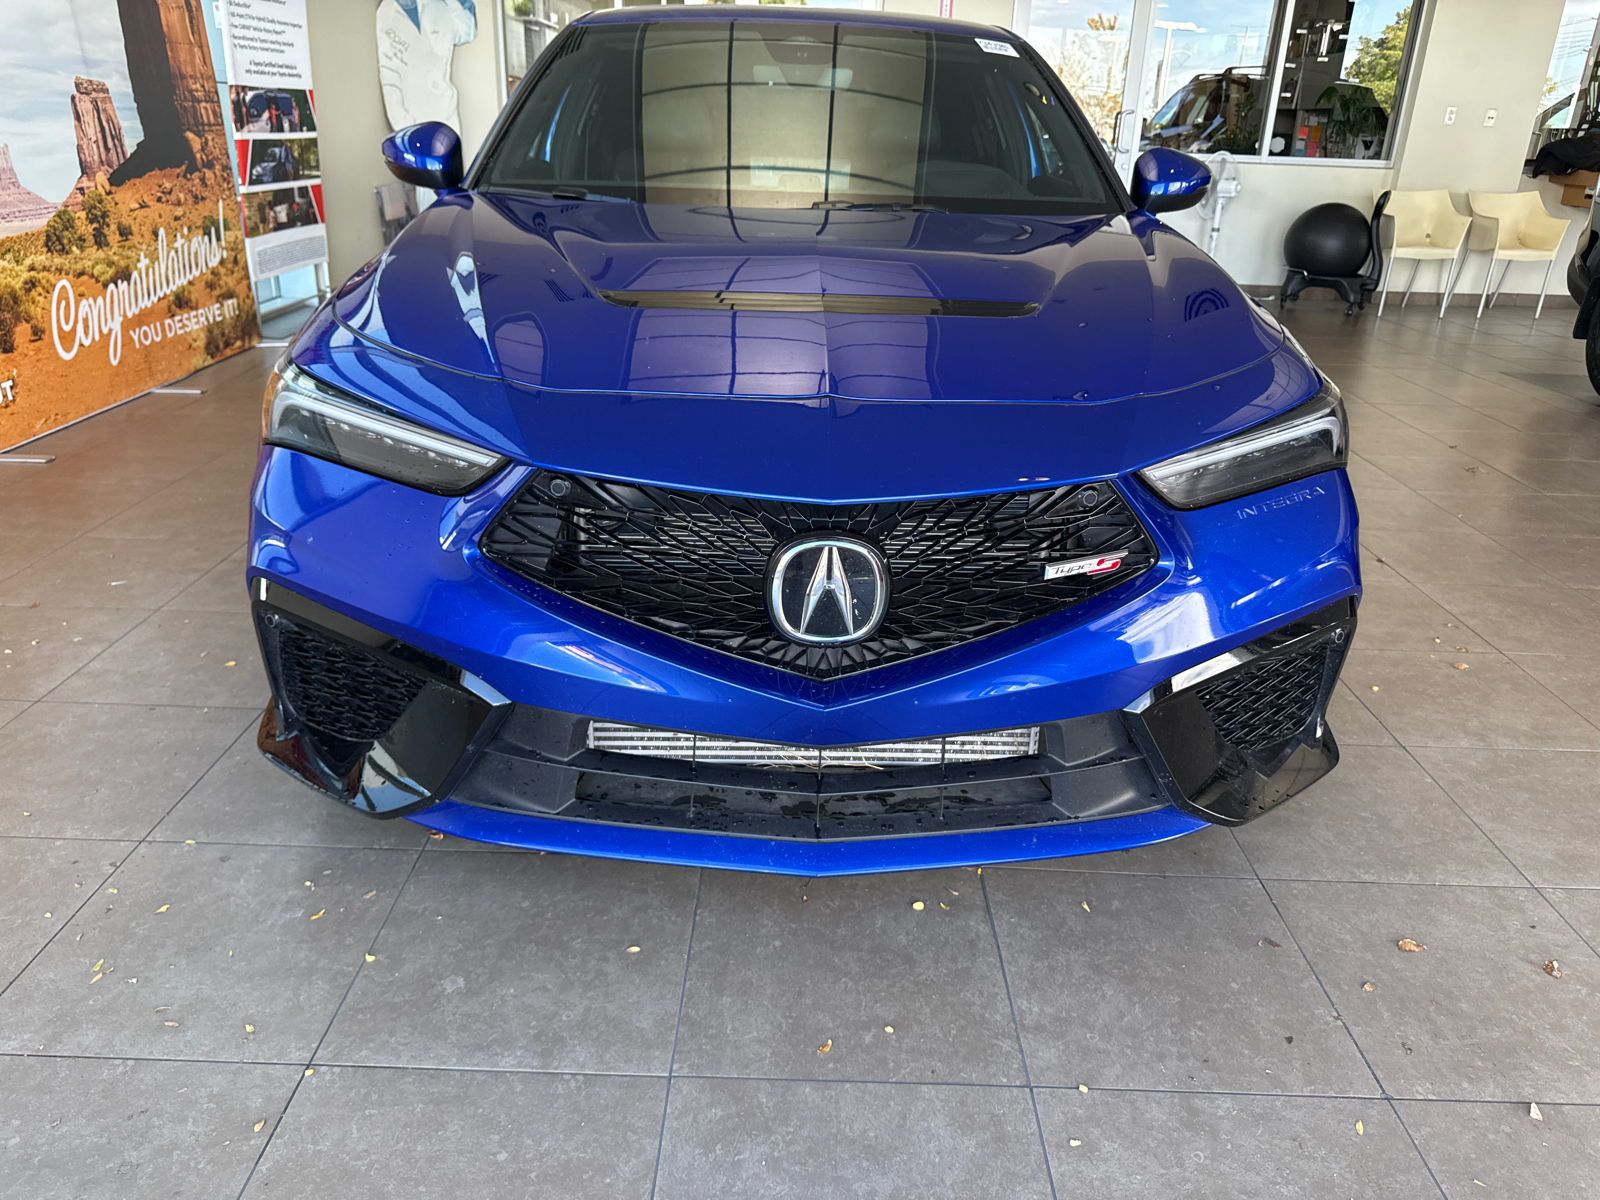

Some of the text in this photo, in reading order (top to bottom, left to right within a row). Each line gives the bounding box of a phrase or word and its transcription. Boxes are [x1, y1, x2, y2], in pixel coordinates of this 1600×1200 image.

[52, 199, 227, 366] Congratulations!
[129, 298, 239, 348] YOU DESERVE IT!
[1236, 486, 1326, 520] INTEGRA
[1087, 555, 1122, 575] S
